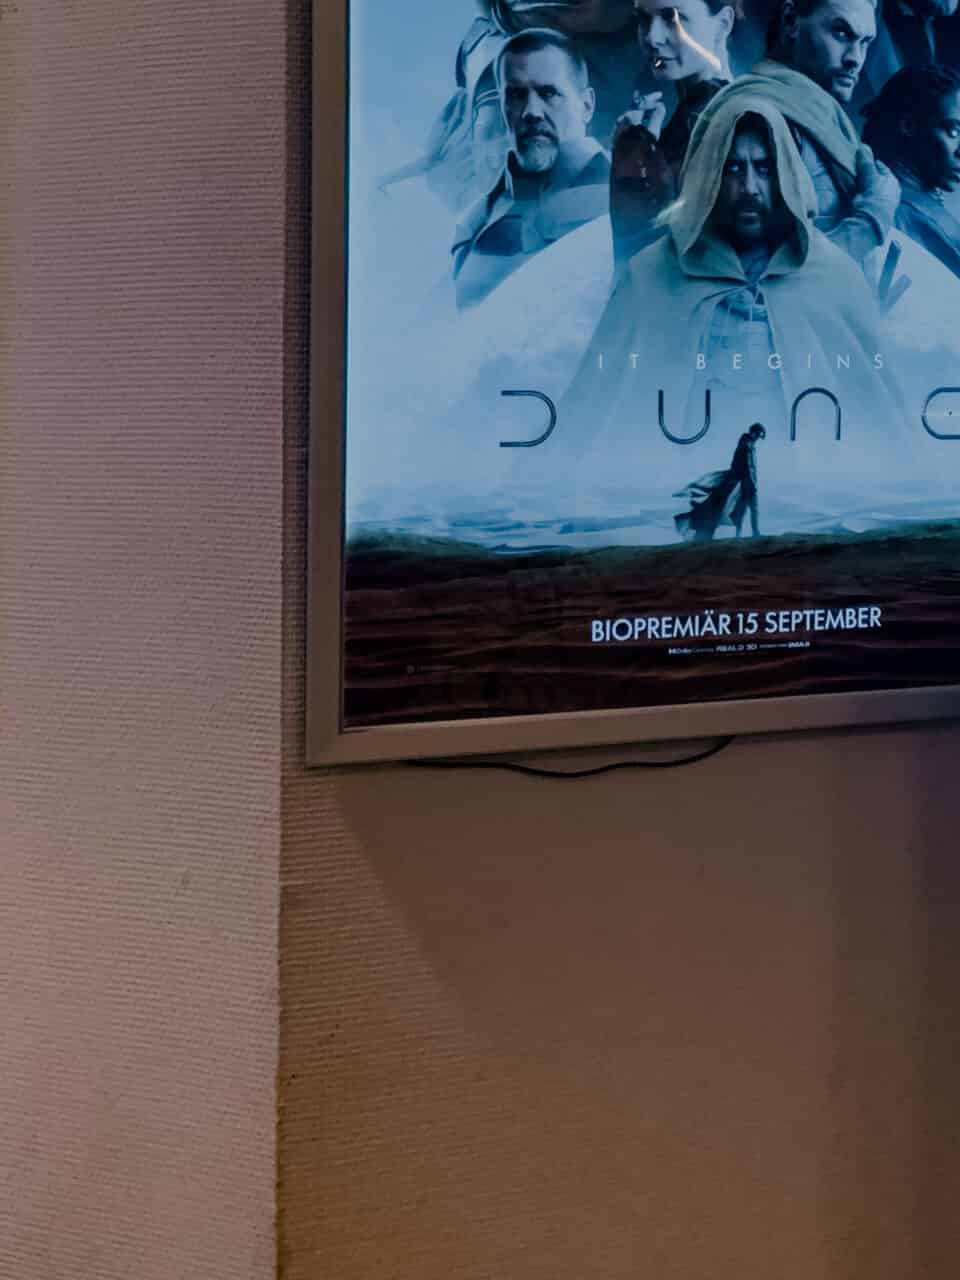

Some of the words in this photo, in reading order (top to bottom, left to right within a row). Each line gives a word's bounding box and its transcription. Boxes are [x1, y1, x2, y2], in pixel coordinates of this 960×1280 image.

[598, 353, 641, 369] IT
[696, 352, 884, 370] BEGINS
[591, 610, 731, 642] BIOPREMIÄR
[738, 613, 758, 635] 15
[765, 607, 882, 633] SEPTEMBER
